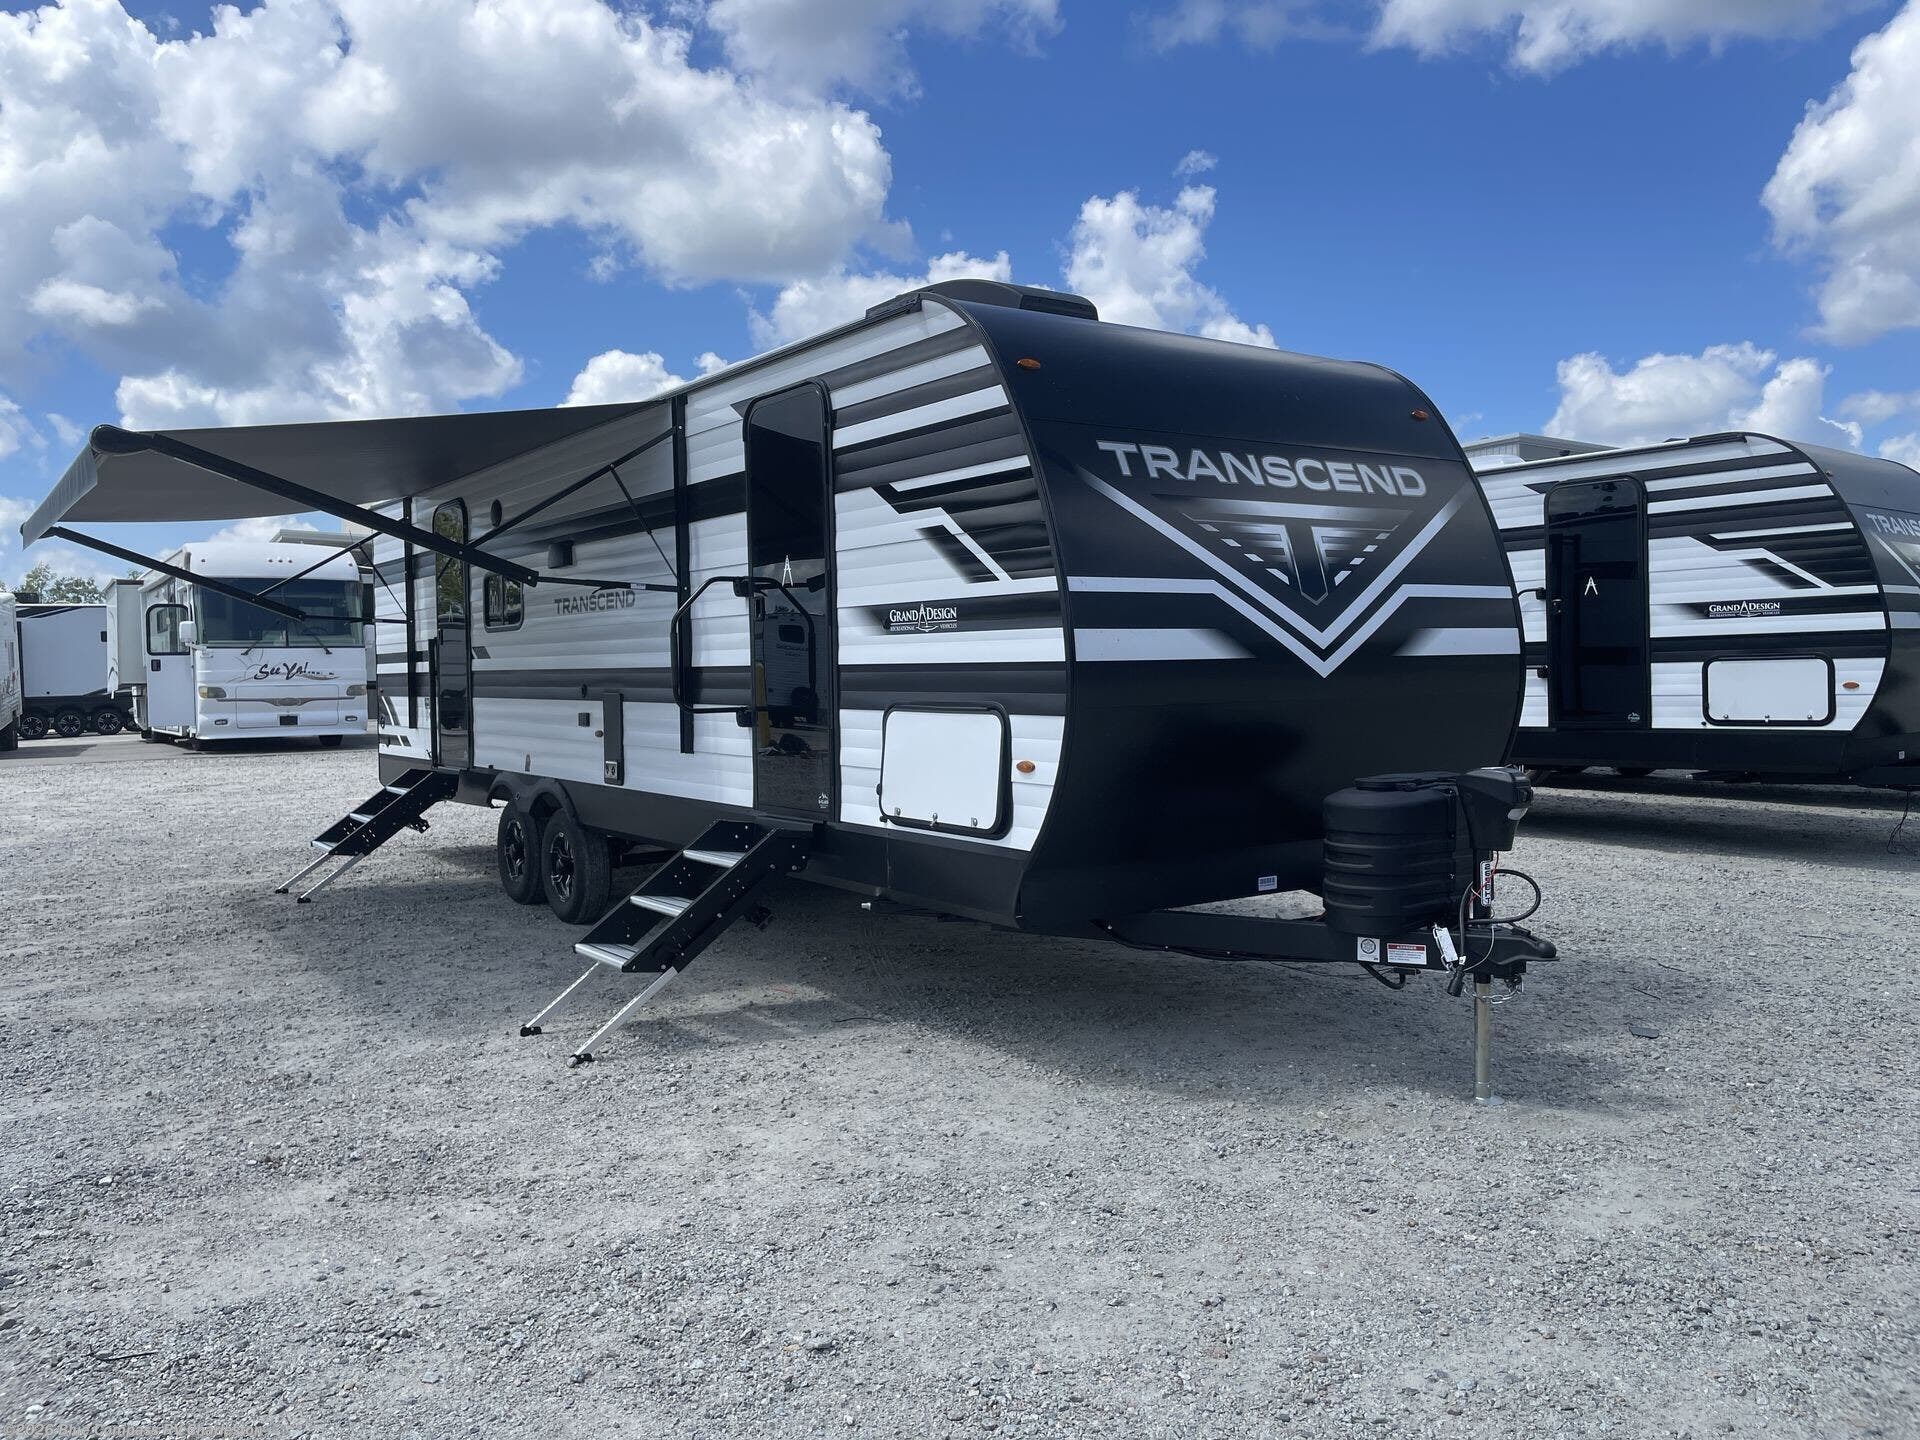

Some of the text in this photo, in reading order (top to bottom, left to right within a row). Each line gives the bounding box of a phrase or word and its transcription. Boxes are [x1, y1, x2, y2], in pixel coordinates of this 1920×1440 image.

[1096, 440, 1427, 497] TRANSCEND
[1866, 513, 1920, 537] TRANS
[554, 590, 636, 614] TRANSCEND
[1709, 602, 1780, 613] GRAND DESIGN
[889, 607, 957, 622] GRAND DESIGN
[253, 663, 280, 680] See
